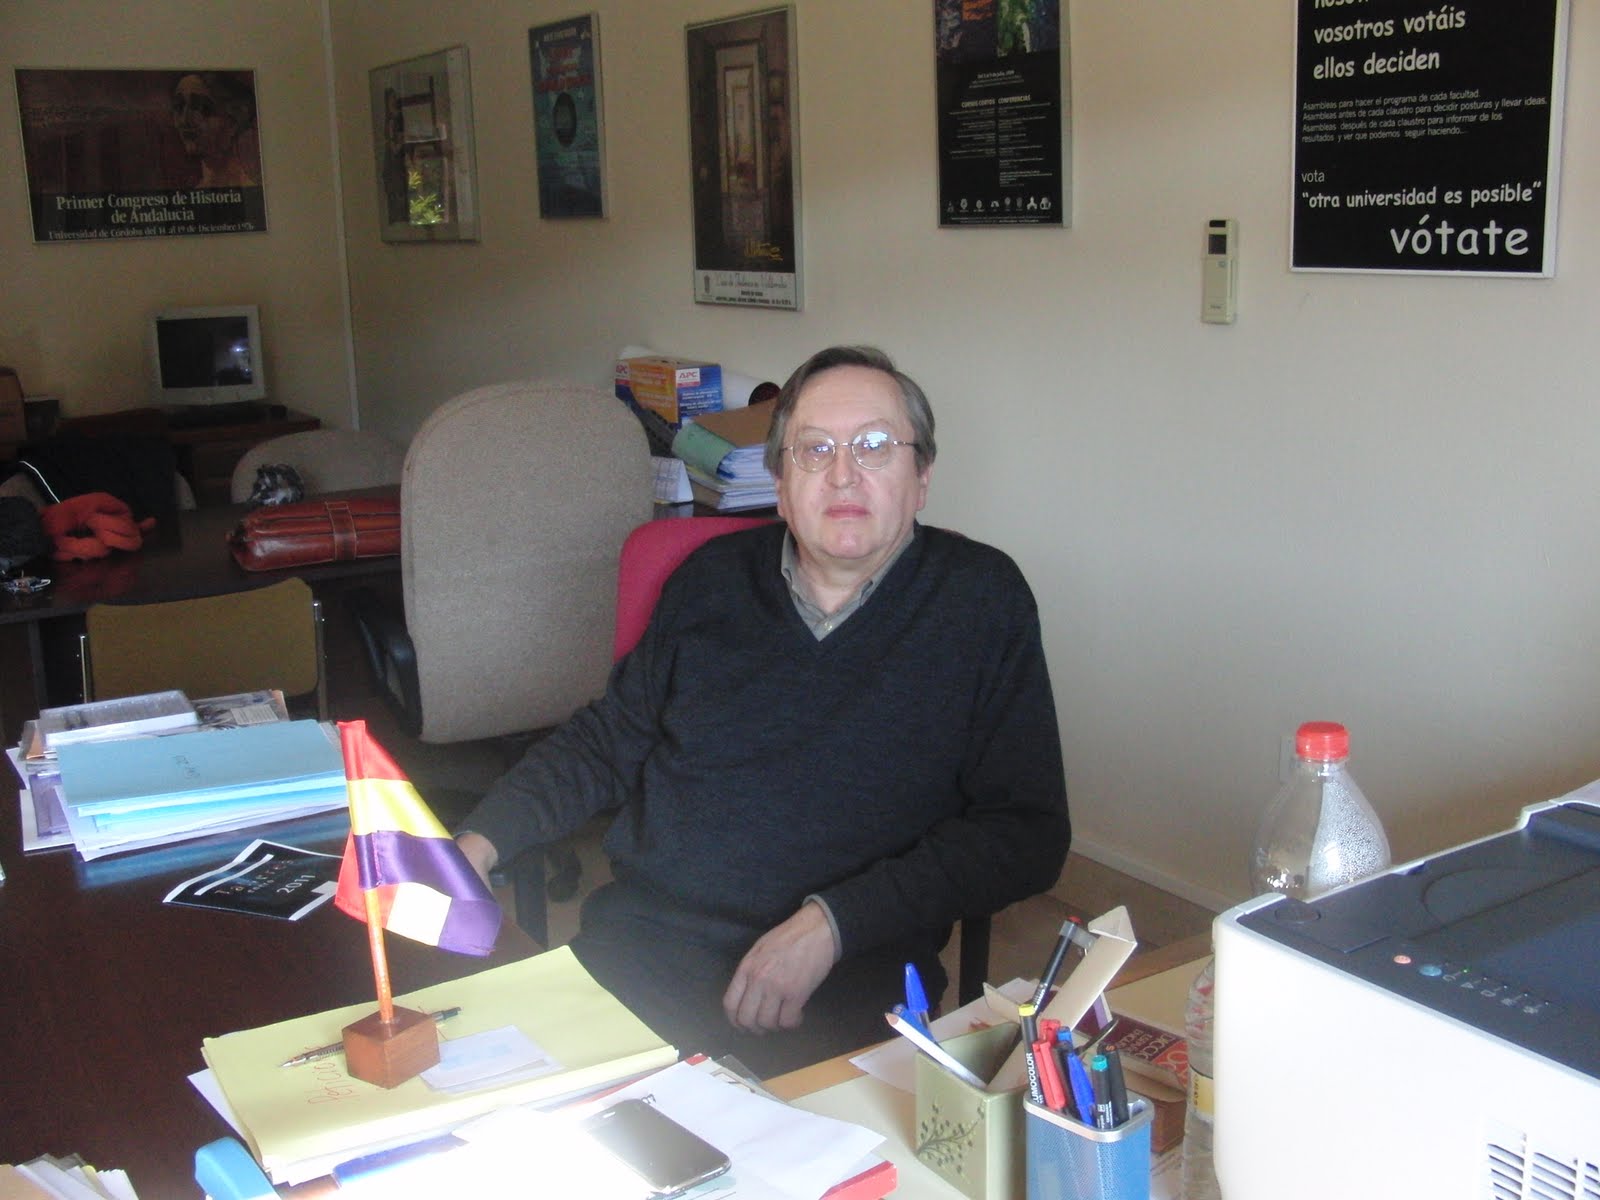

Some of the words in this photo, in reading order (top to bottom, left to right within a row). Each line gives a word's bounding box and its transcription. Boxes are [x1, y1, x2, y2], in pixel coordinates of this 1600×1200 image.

[1314, 19, 1394, 44] vosotros
[1403, 4, 1466, 34] votáis
[1313, 56, 1355, 79] ellos
[1363, 47, 1440, 74] deciden
[1303, 102, 1337, 110] Asambleas
[1339, 100, 1354, 109] para
[1355, 98, 1374, 106] hacer
[1375, 97, 1382, 105] el
[1384, 95, 1417, 106] programa
[1419, 93, 1428, 102] de
[1430, 92, 1448, 101] cada
[1303, 112, 1337, 120] Asambleas
[1338, 110, 1356, 119] antes
[1358, 109, 1367, 117] de
[1368, 108, 1384, 117] cada
[1386, 106, 1414, 115] claustro
[1415, 105, 1431, 114] para
[1433, 103, 1459, 112] decidir
[1460, 100, 1492, 111] posturas
[1494, 101, 1500, 110] y
[1501, 98, 1521, 107] llevar
[1303, 123, 1337, 132] Asambleas
[1340, 120, 1367, 131] después
[1369, 119, 1378, 128] de
[1379, 118, 1396, 128] cada
[1397, 117, 1425, 127] claustro
[1427, 116, 1444, 126] para
[1446, 114, 1477, 124] informar
[1479, 112, 1489, 121] de
[1491, 112, 1503, 121] los
[1302, 134, 1335, 143] resultados
[1355, 132, 1368, 141] que
[1369, 130, 1400, 140] podemos
[1404, 128, 1427, 139] seguir
[1301, 170, 1325, 183] vota
[56, 195, 105, 210] Primer
[107, 193, 169, 209] Congreso
[172, 191, 188, 205] de
[190, 189, 242, 205] Historia
[1346, 186, 1437, 208] universidad
[1443, 190, 1463, 204] es
[111, 209, 127, 223] de
[48, 229, 97, 240] Universidad
[98, 229, 109, 238] de
[145, 225, 157, 236] del
[187, 223, 195, 233] de
[1390, 214, 1529, 256] vótate
[679, 371, 698, 379] APC
[275, 873, 317, 894] 2011
